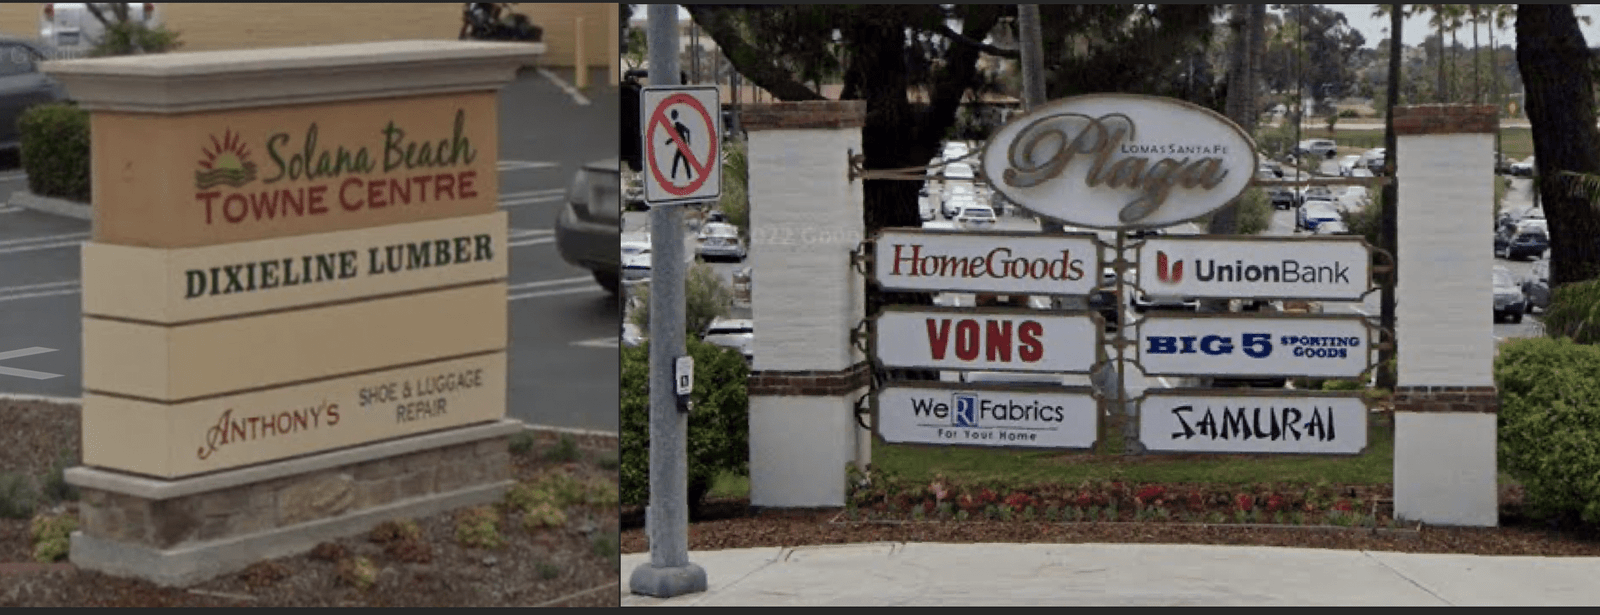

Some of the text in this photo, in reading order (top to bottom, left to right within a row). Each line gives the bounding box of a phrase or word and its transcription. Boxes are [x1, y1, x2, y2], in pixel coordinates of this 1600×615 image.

[263, 108, 477, 184] Solana Beach
[195, 170, 479, 224] TOWNE CENTRE
[184, 233, 494, 299] DIXIELINE LUMBER
[889, 244, 1085, 281] HomeGoods
[1195, 259, 1350, 283] UnionBank
[926, 318, 1045, 363] VONS
[1146, 333, 1360, 358] BIG 5 SPORTING
[1292, 346, 1348, 359] GOODS
[358, 368, 483, 407] SHOE & LUGGAGE
[395, 397, 448, 424] REPAIR
[911, 394, 1064, 426] We R Fabrics
[1171, 405, 1336, 442] SAMURAI
[938, 428, 1037, 442] For Your Home
